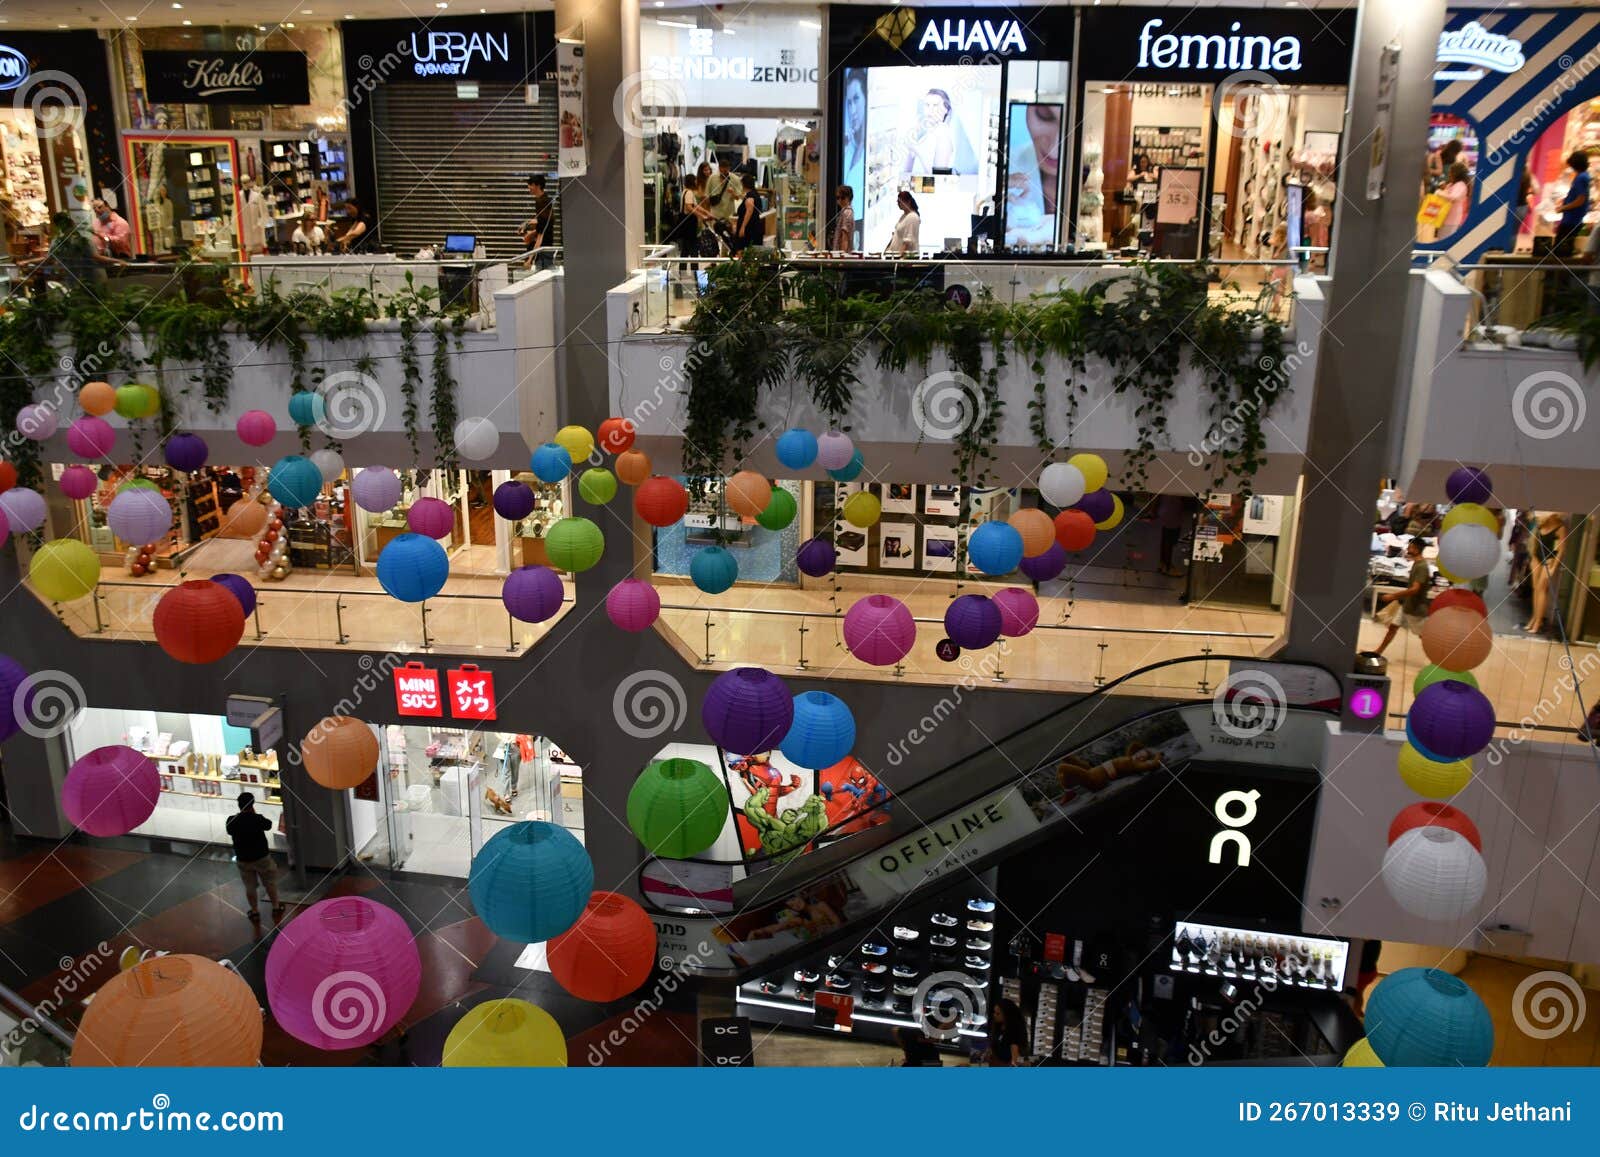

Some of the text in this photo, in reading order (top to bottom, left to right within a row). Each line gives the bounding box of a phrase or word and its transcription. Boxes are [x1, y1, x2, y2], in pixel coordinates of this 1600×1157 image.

[411, 31, 509, 75] URBAN
[918, 18, 1027, 52] AHAVA
[1137, 18, 1302, 71] femina
[183, 57, 264, 96] Kiehl's
[414, 62, 461, 77] eyewear
[398, 677, 436, 693] MINI
[879, 803, 1004, 873] OFFLINE
